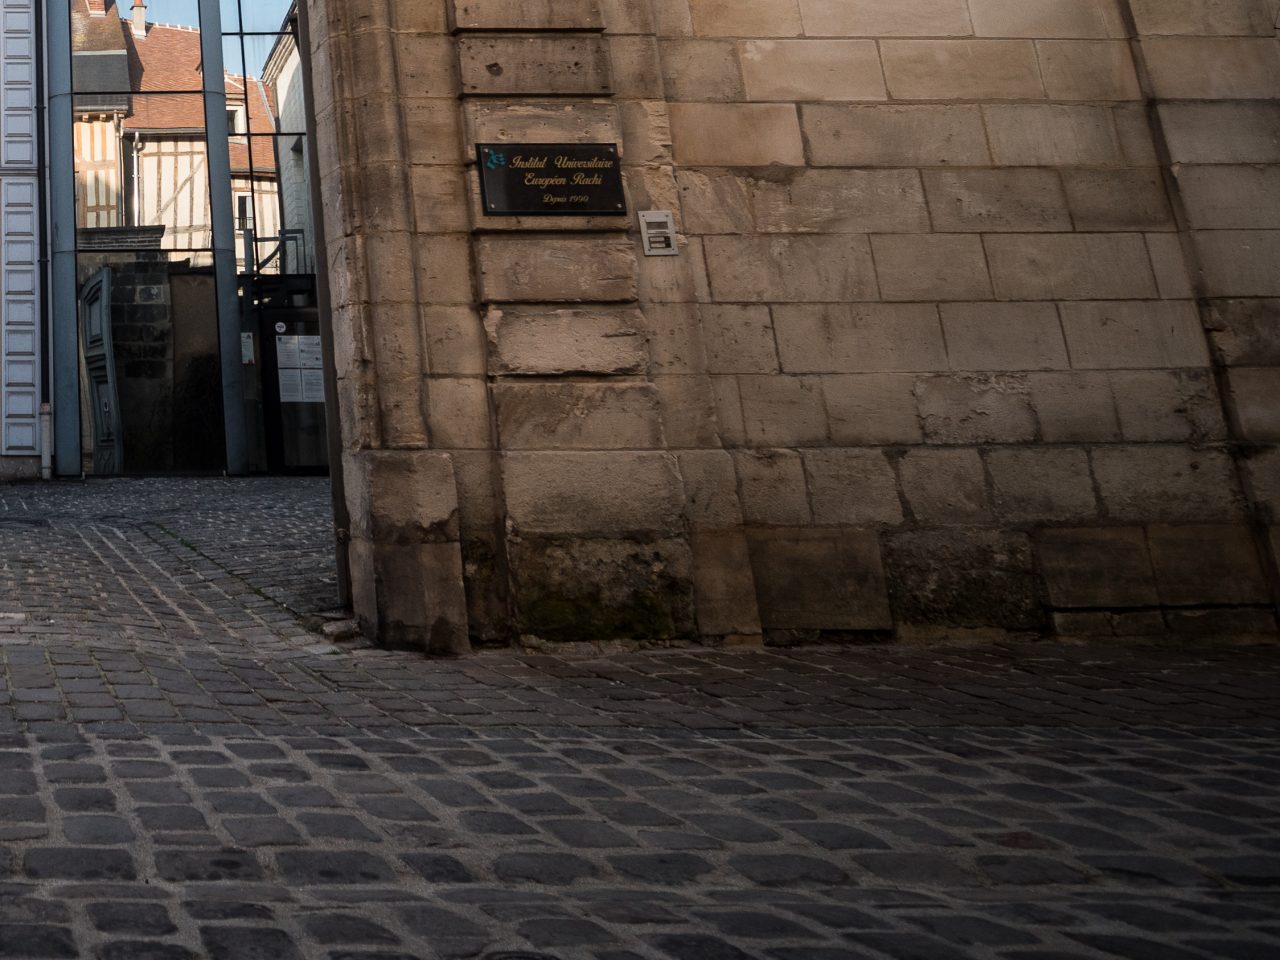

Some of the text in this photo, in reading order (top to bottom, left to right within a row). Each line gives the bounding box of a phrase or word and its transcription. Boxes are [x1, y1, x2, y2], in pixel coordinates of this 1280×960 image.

[509, 155, 613, 168] Institut Universitaire
[524, 172, 602, 188] Européen Rachi
[543, 193, 589, 205] Depuis 1990
